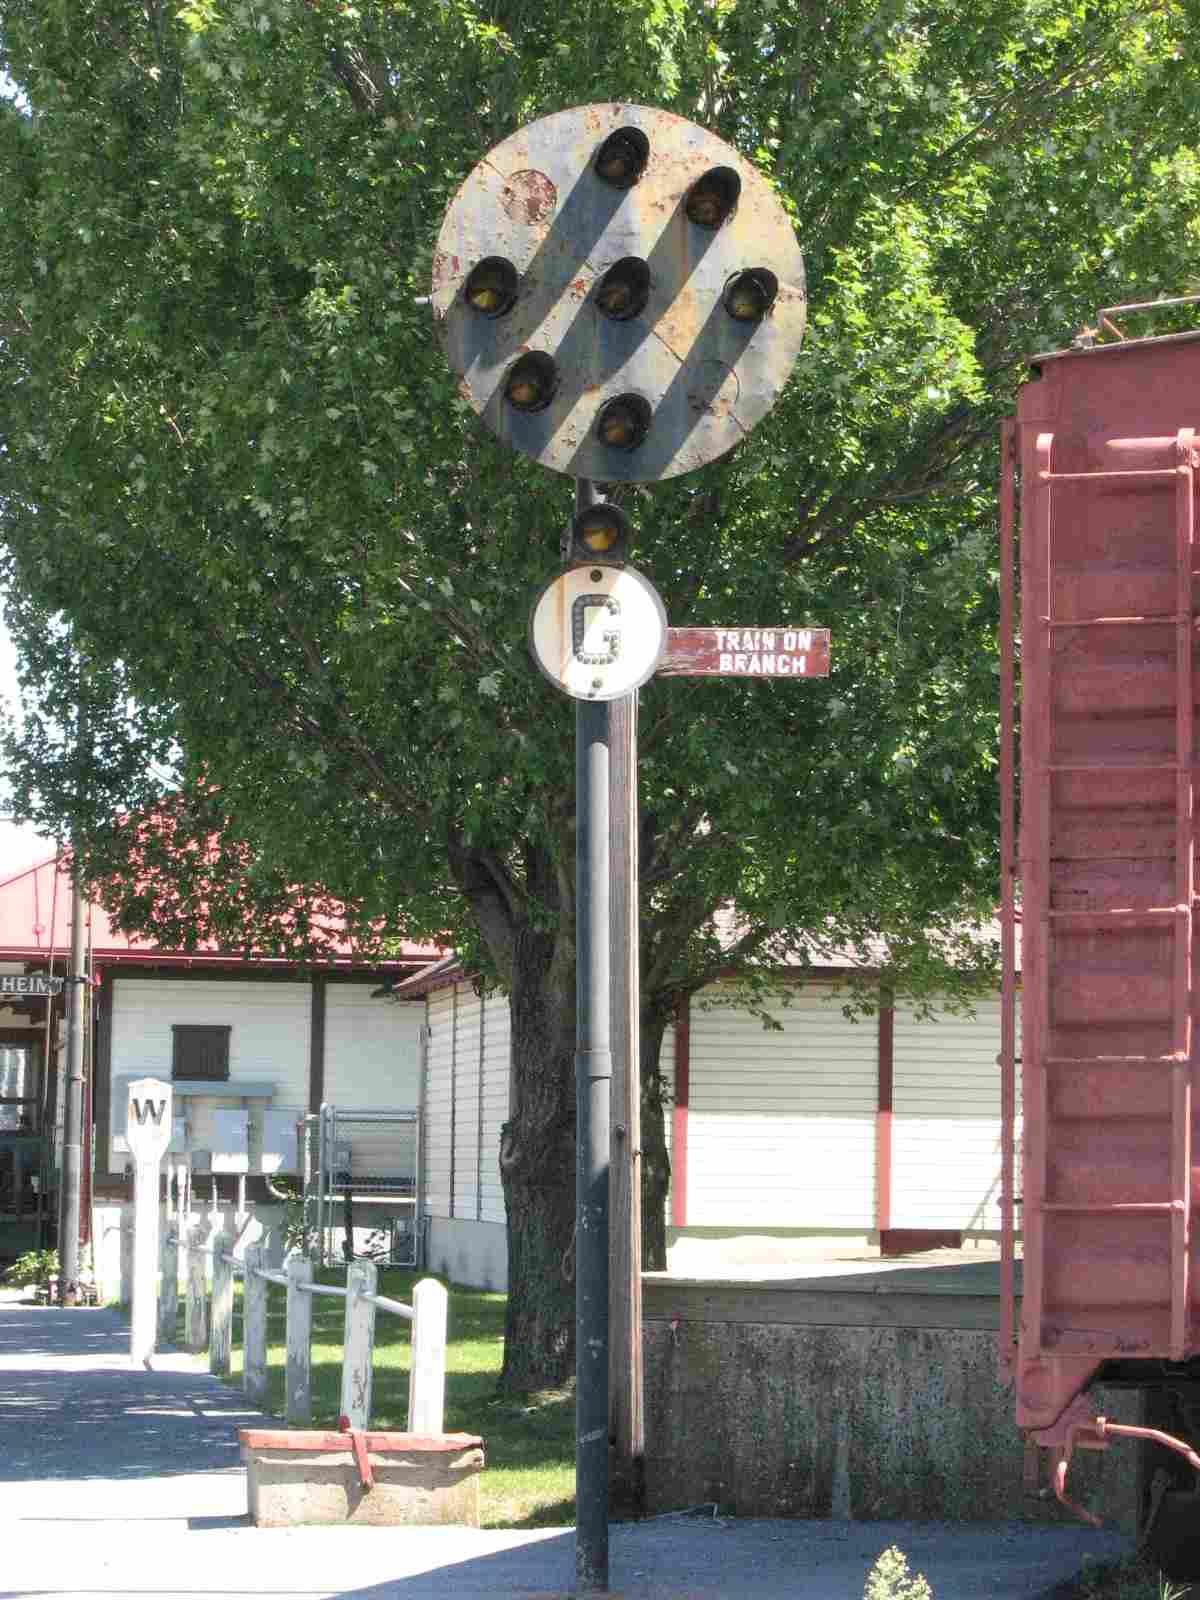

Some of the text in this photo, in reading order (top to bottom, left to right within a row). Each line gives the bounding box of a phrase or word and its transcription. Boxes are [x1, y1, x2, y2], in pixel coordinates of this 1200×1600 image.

[572, 594, 619, 664] G
[714, 631, 812, 650] TRAIN ON
[719, 654, 806, 673] BRANCH
[133, 1098, 167, 1126] W
